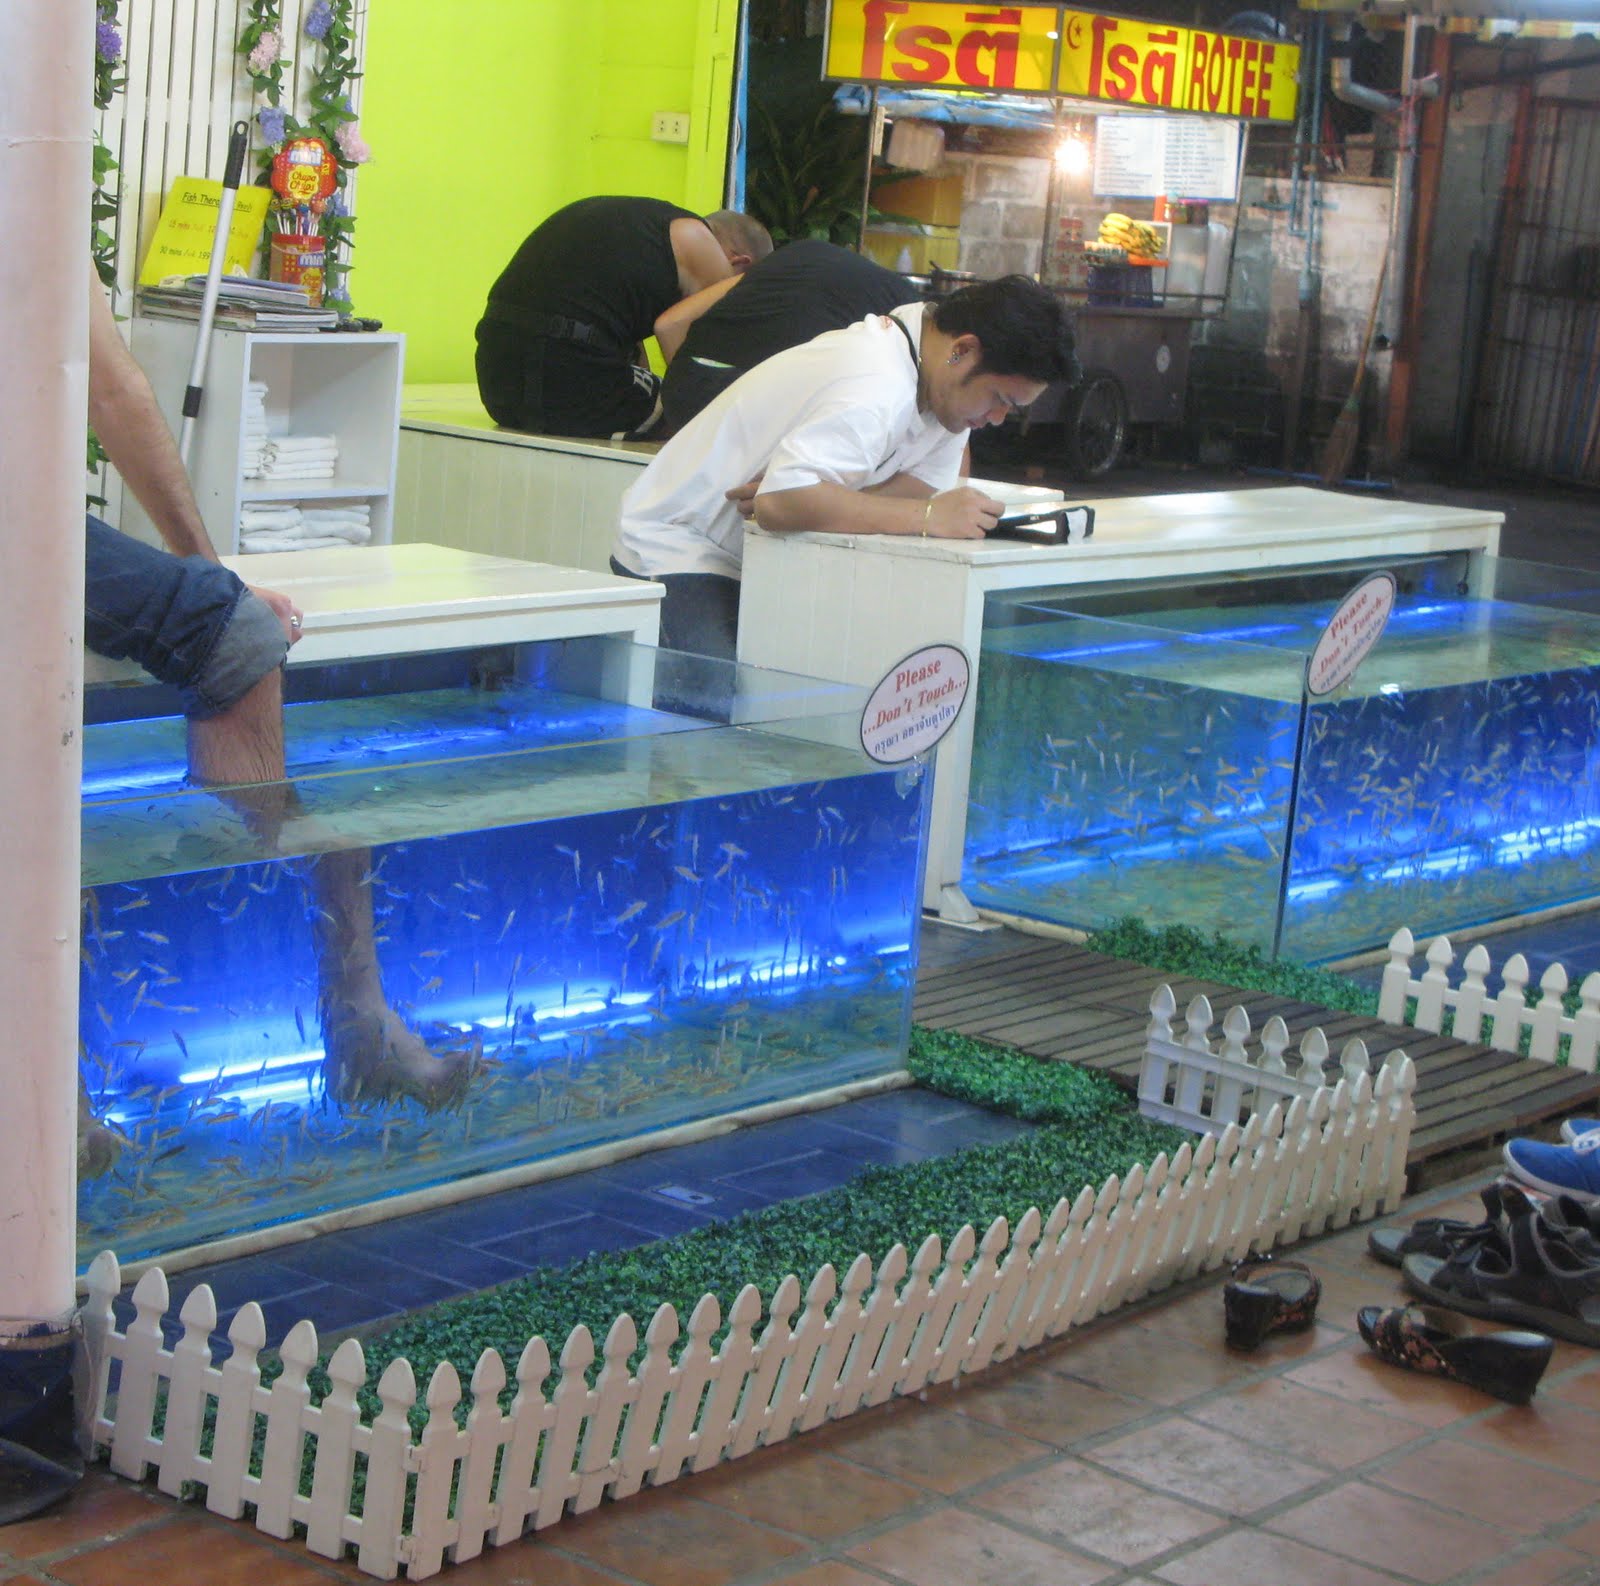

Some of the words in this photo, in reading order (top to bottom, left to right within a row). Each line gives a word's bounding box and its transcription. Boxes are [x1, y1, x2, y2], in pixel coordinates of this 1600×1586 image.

[863, 1, 1021, 88] โรตี
[1088, 14, 1177, 106] โรตี
[1192, 33, 1275, 118] ROTEE
[289, 180, 316, 192] Chups
[291, 171, 317, 183] Chupa
[1331, 593, 1367, 639] Please
[895, 659, 941, 693] Please
